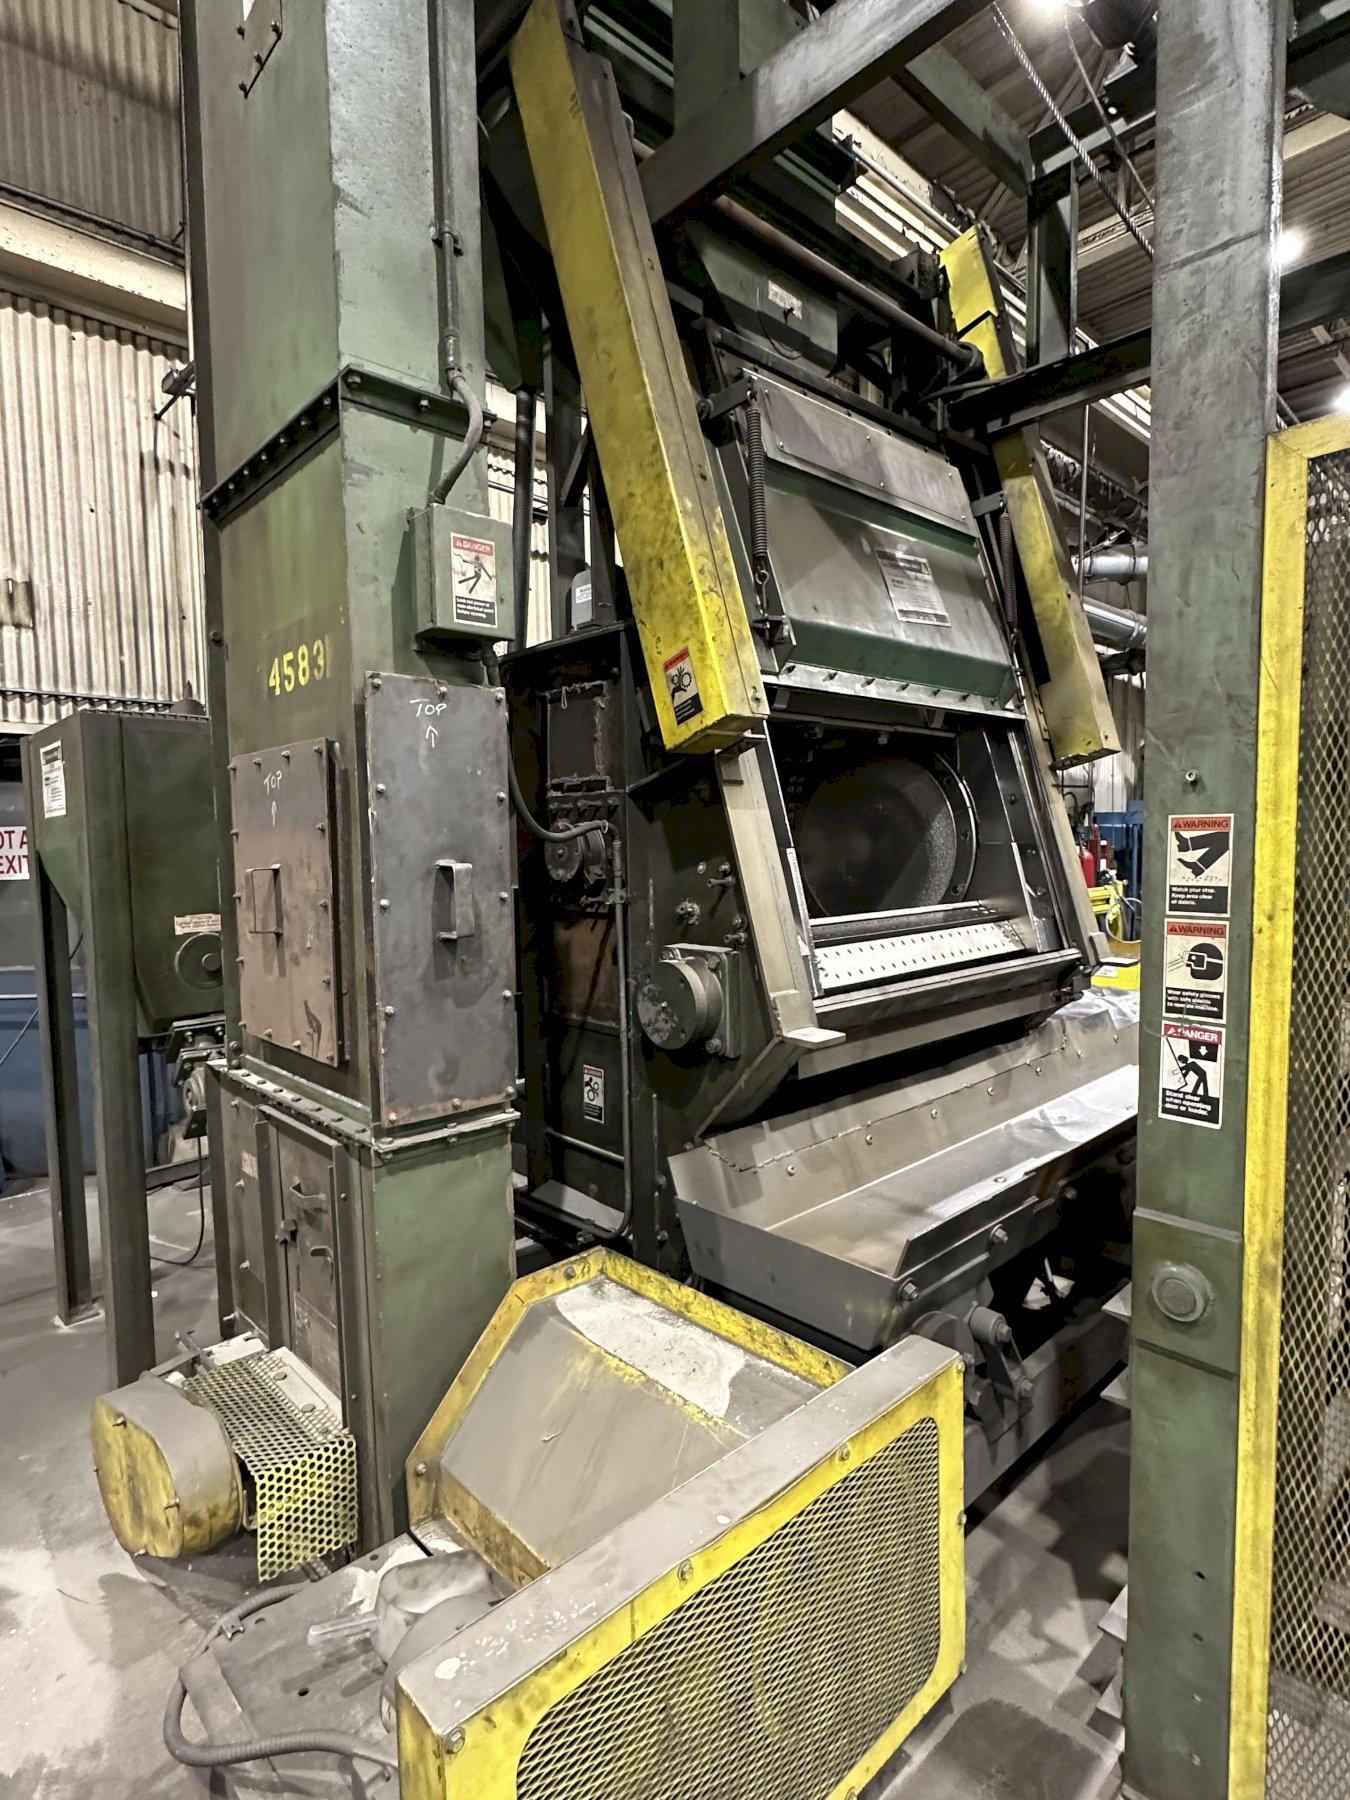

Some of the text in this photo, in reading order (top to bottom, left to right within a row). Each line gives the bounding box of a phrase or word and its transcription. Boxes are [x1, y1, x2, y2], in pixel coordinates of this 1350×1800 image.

[462, 540, 490, 552] DANGER
[268, 639, 324, 696] 4583
[409, 698, 447, 717] TOP
[263, 770, 282, 795] TOP
[1182, 819, 1229, 829] WARNING
[1178, 925, 1224, 936] WARNING
[1165, 1090, 1183, 1098] Stand
[1182, 1100, 1212, 1111] operating
